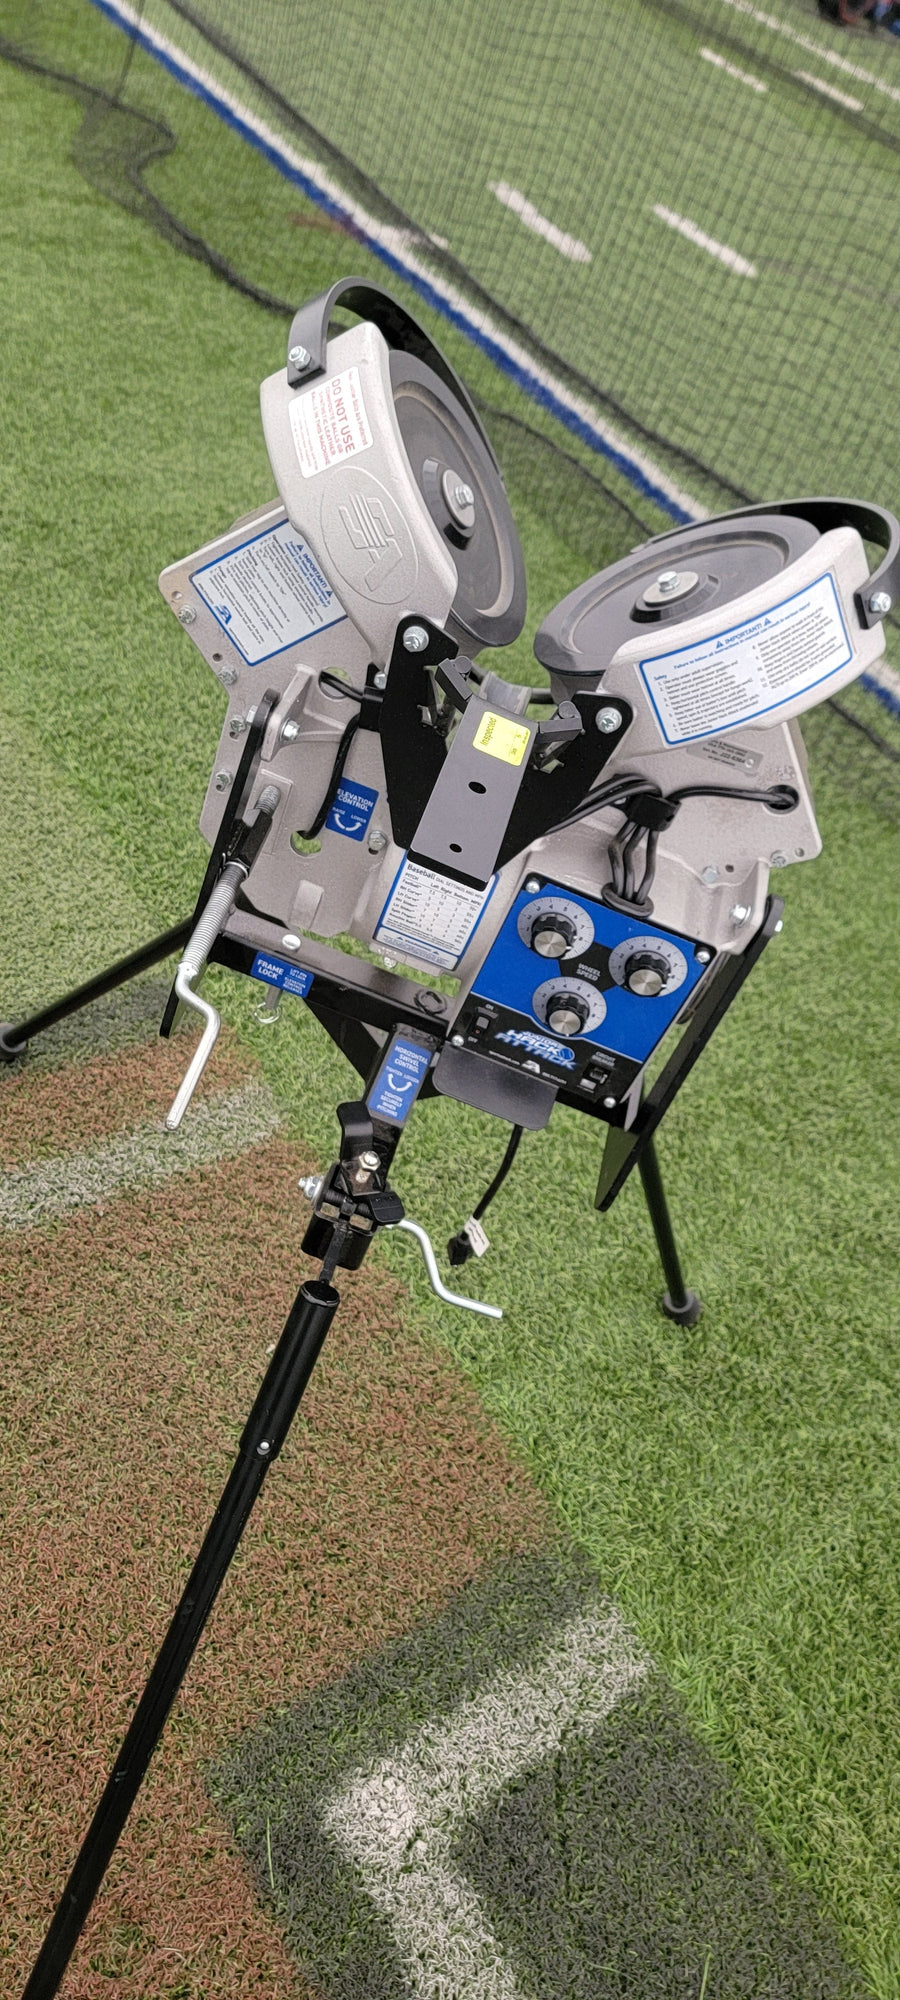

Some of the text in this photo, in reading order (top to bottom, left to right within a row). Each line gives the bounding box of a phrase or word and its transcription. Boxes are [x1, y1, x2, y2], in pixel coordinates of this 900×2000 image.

[332, 378, 355, 453] DO NOT USE
[324, 426, 335, 455] LEATHER
[319, 434, 330, 466] MACHINE
[303, 553, 327, 588] IMPORTANT!
[725, 623, 762, 644] IMPORTANT!
[337, 788, 373, 807] ELEVATION
[338, 794, 368, 811] CONTROL
[407, 864, 436, 879] Baseball
[258, 959, 284, 975] FRAME
[258, 967, 279, 979] LOCK
[576, 969, 598, 981] SPEED
[579, 963, 600, 976] WHEEL
[494, 1032, 578, 1071] ATTACK
[507, 1029, 562, 1056] HACK
[395, 1046, 427, 1064] HORIZONTAL
[399, 1054, 418, 1066] SWIVEL
[394, 1058, 418, 1073] CONTROL
